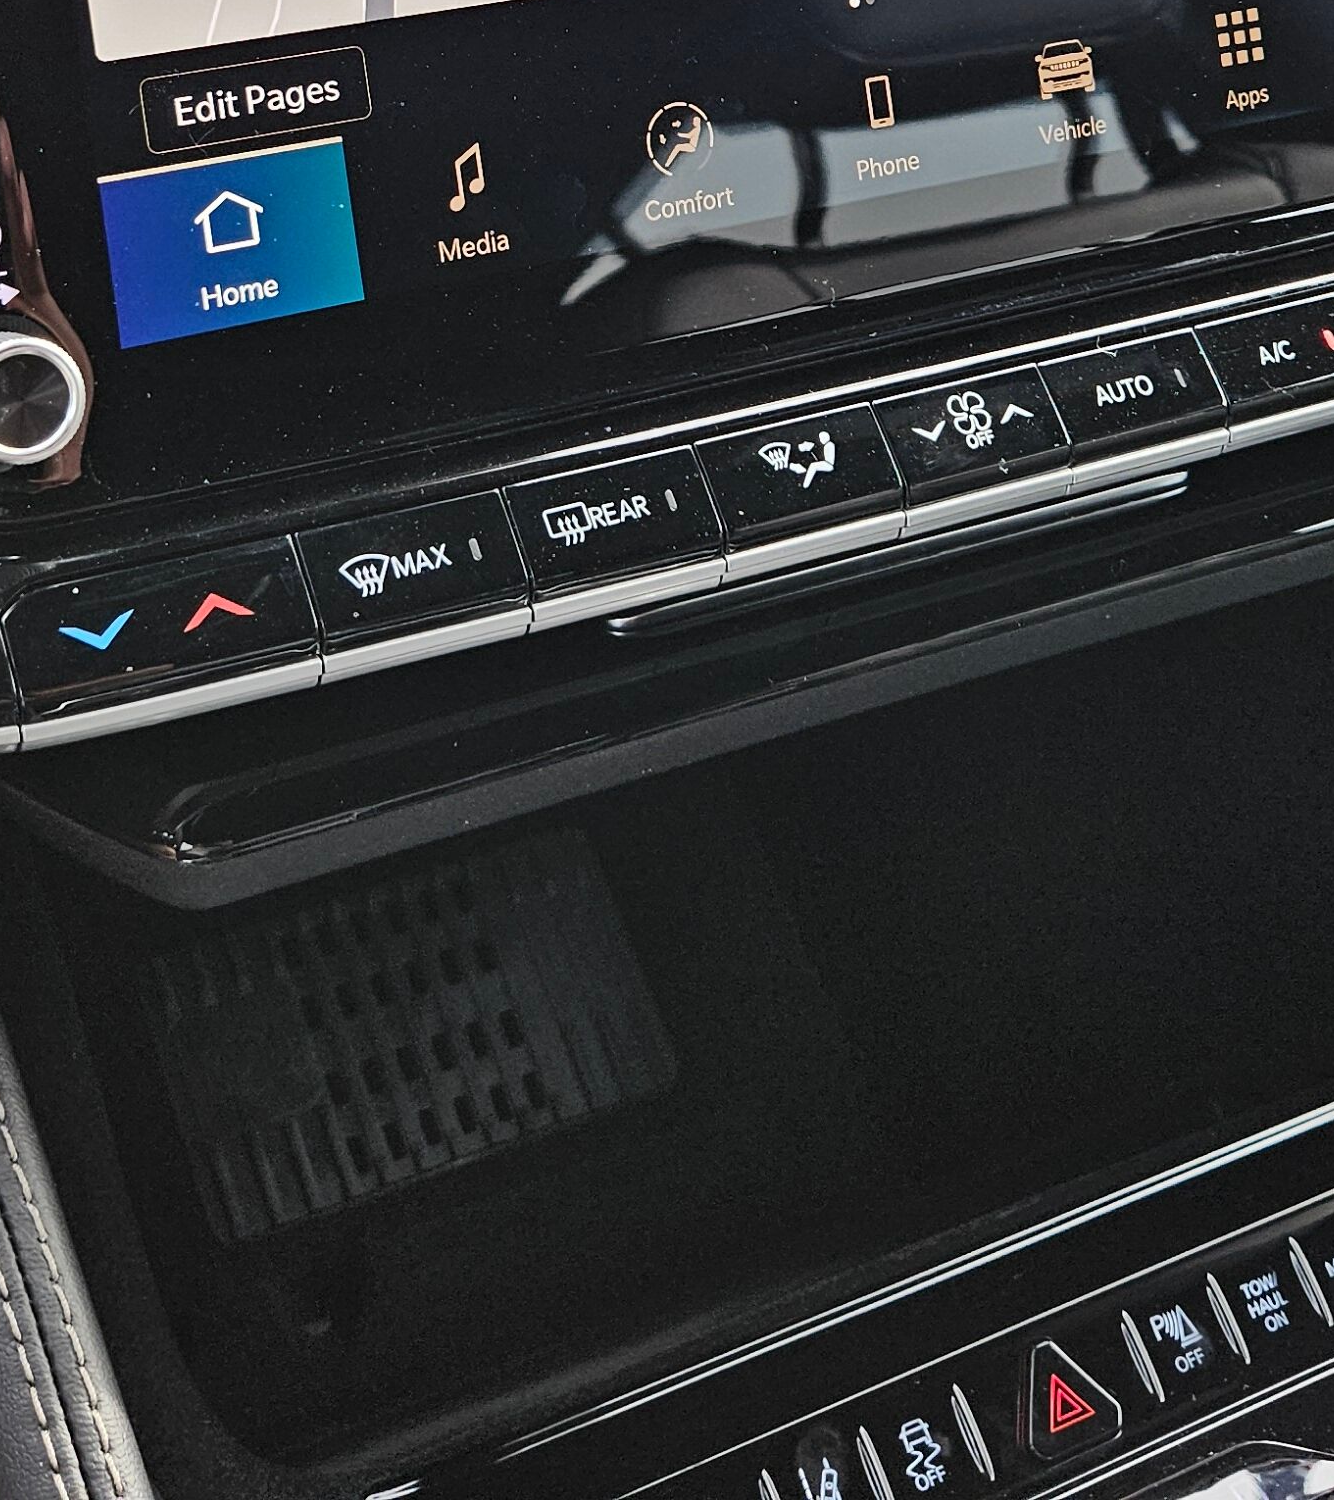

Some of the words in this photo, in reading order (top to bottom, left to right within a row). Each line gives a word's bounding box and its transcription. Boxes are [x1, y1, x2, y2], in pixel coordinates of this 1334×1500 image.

[174, 94, 240, 126] Edit
[246, 77, 340, 116] Pages
[1226, 86, 1269, 111] Apps
[1039, 115, 1107, 145] Vehicle
[857, 153, 919, 181] Phone
[644, 188, 735, 221] Comfort
[438, 231, 510, 263] Media
[201, 281, 279, 311] Home
[1258, 339, 1296, 366] A/C
[1096, 374, 1154, 405] AUTO
[966, 429, 995, 450] OFF
[591, 495, 651, 530] REAR
[390, 543, 453, 579] MAX
[1247, 1290, 1289, 1319] HAUL
[1264, 1310, 1290, 1332] ON
[1174, 1347, 1206, 1373] OFF
[914, 1464, 947, 1492] OFF
